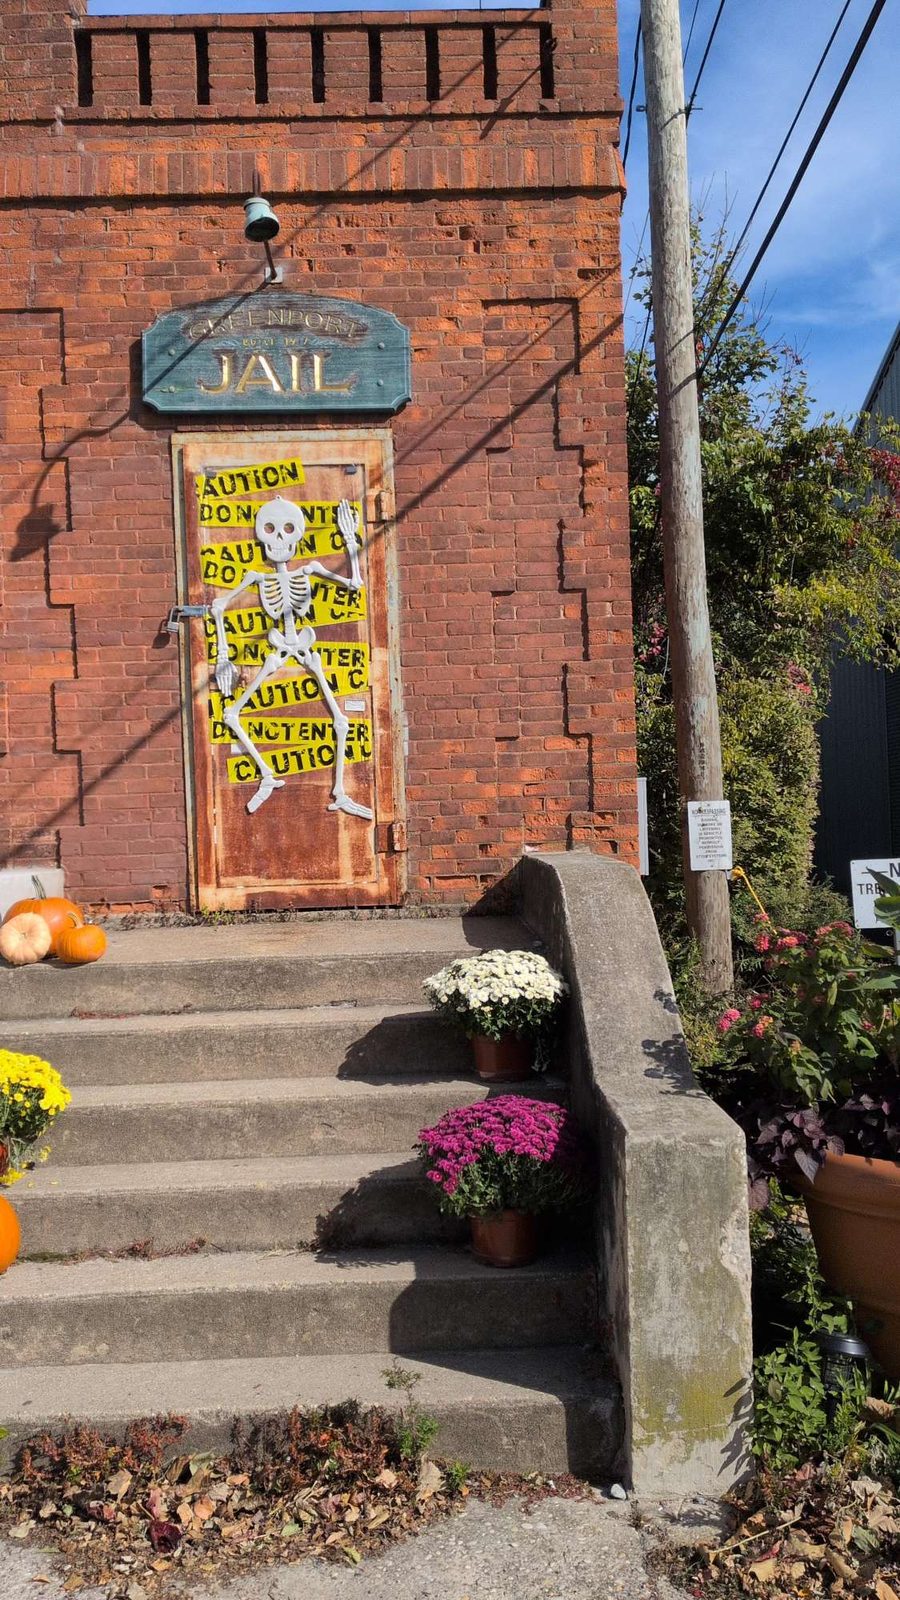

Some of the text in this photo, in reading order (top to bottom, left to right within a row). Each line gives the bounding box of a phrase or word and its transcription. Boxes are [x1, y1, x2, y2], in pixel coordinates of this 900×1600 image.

[189, 308, 368, 339] GREENPORT
[200, 354, 352, 394] JAIL
[200, 504, 232, 523] DO
[301, 505, 358, 524] NTE
[200, 534, 317, 564] AUTN
[204, 561, 236, 583] DO
[204, 604, 316, 638] CAUTN
[299, 723, 369, 742] ENTER
